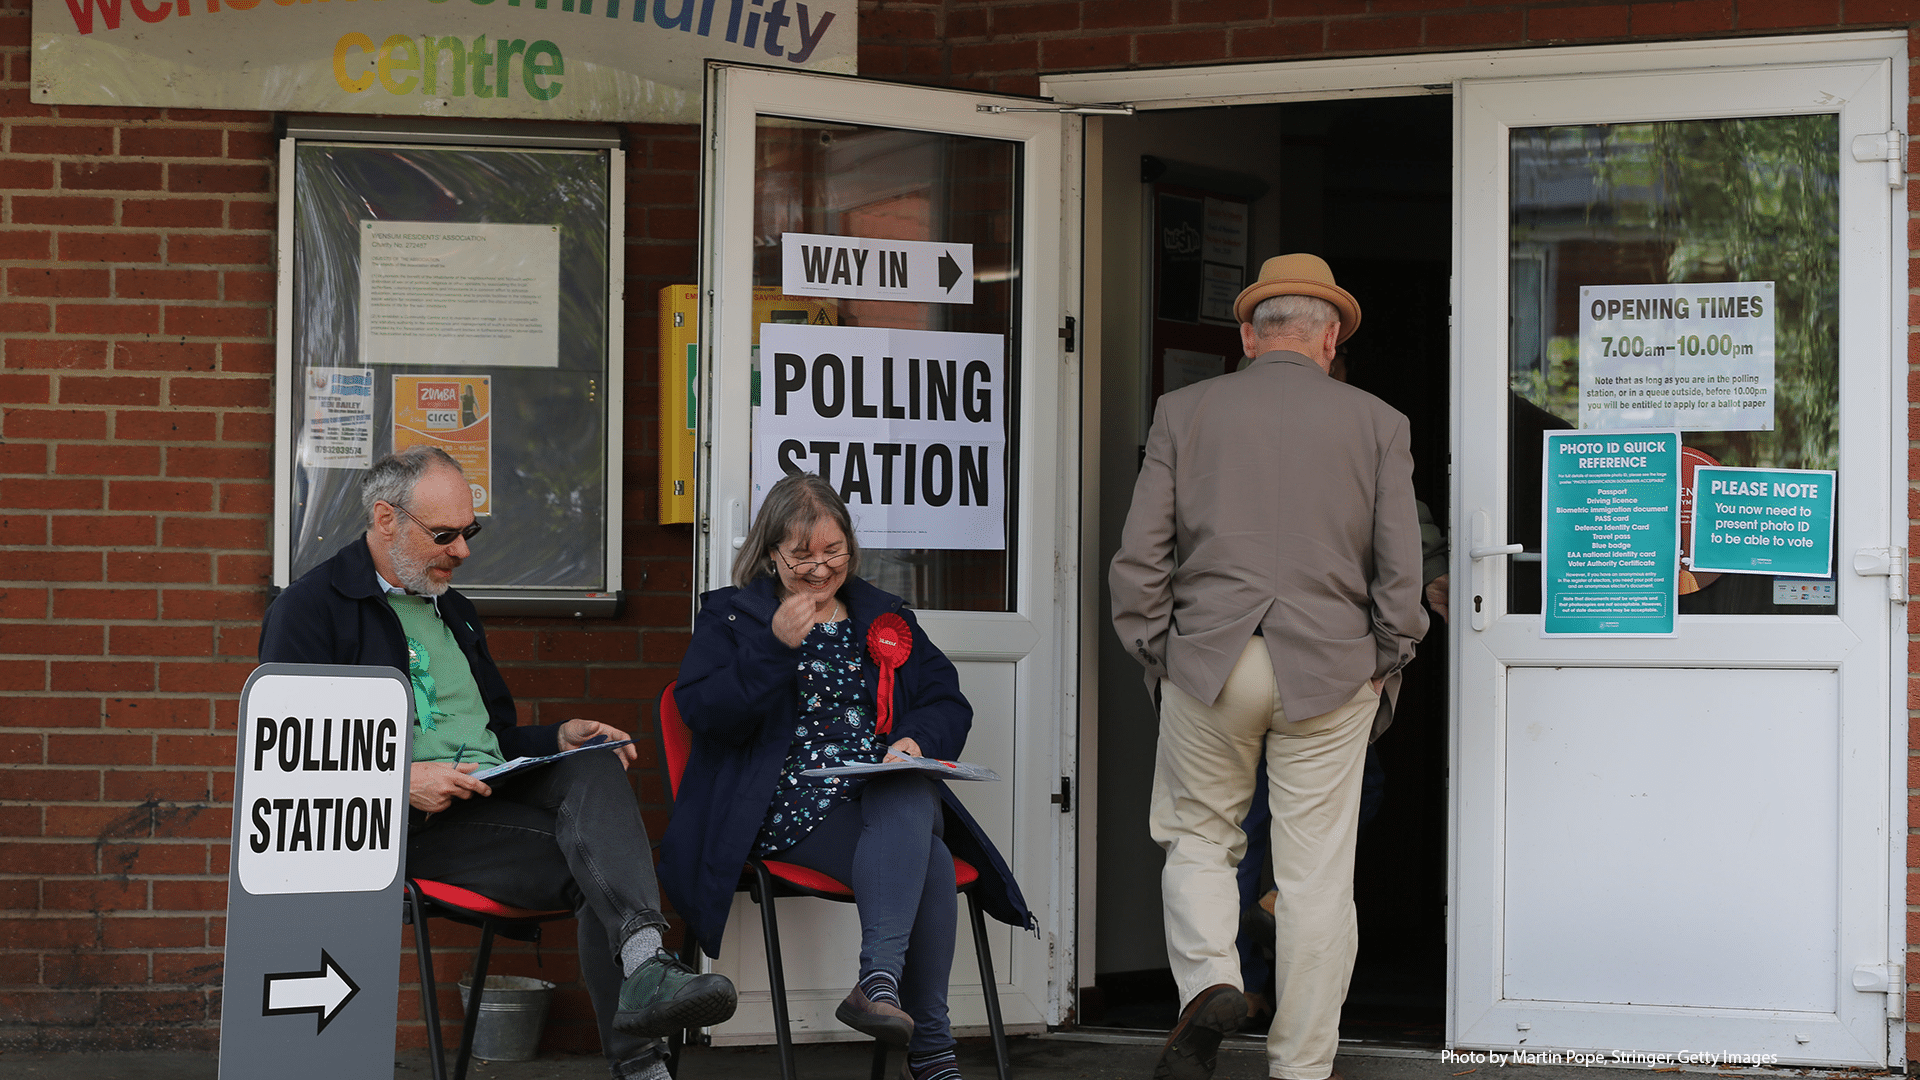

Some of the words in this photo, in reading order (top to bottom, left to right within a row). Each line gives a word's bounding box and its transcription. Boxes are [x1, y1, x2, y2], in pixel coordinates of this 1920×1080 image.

[428, 0, 836, 63] unity
[333, 32, 565, 100] centre
[801, 245, 869, 286] WAY
[879, 250, 908, 288] IN
[1591, 298, 1689, 321] OPENING
[1698, 296, 1763, 318] TIMES
[774, 352, 992, 423] POLLING
[1646, 376, 1662, 386] long
[1732, 375, 1759, 384] polling
[420, 388, 456, 400] ZUMBA
[1587, 389, 1616, 397] station,
[1672, 388, 1703, 396] outside,
[1734, 387, 1767, 396] 10.00pm
[1674, 400, 1695, 410] apply
[1743, 401, 1766, 409] paper
[1560, 443, 1603, 454] PHOTO
[1607, 443, 1620, 453] ID
[1624, 442, 1666, 453] QUICK
[1579, 457, 1646, 468] REFERENCE
[778, 439, 989, 508] STATION
[1712, 481, 1768, 496] PLEASE
[1774, 483, 1818, 498] NOTE
[1715, 503, 1736, 513] You
[1739, 506, 1763, 514] now
[1766, 505, 1797, 516] need
[1800, 506, 1812, 517] to
[1716, 519, 1758, 531] present
[1761, 520, 1795, 532] photo
[1798, 522, 1810, 532] ID
[1711, 533, 1723, 543] to
[1725, 534, 1741, 544] be
[1744, 534, 1770, 545] able
[1773, 536, 1785, 546] to
[1787, 536, 1813, 548] vote
[254, 716, 397, 772] POLLING
[250, 797, 392, 854] STATION
